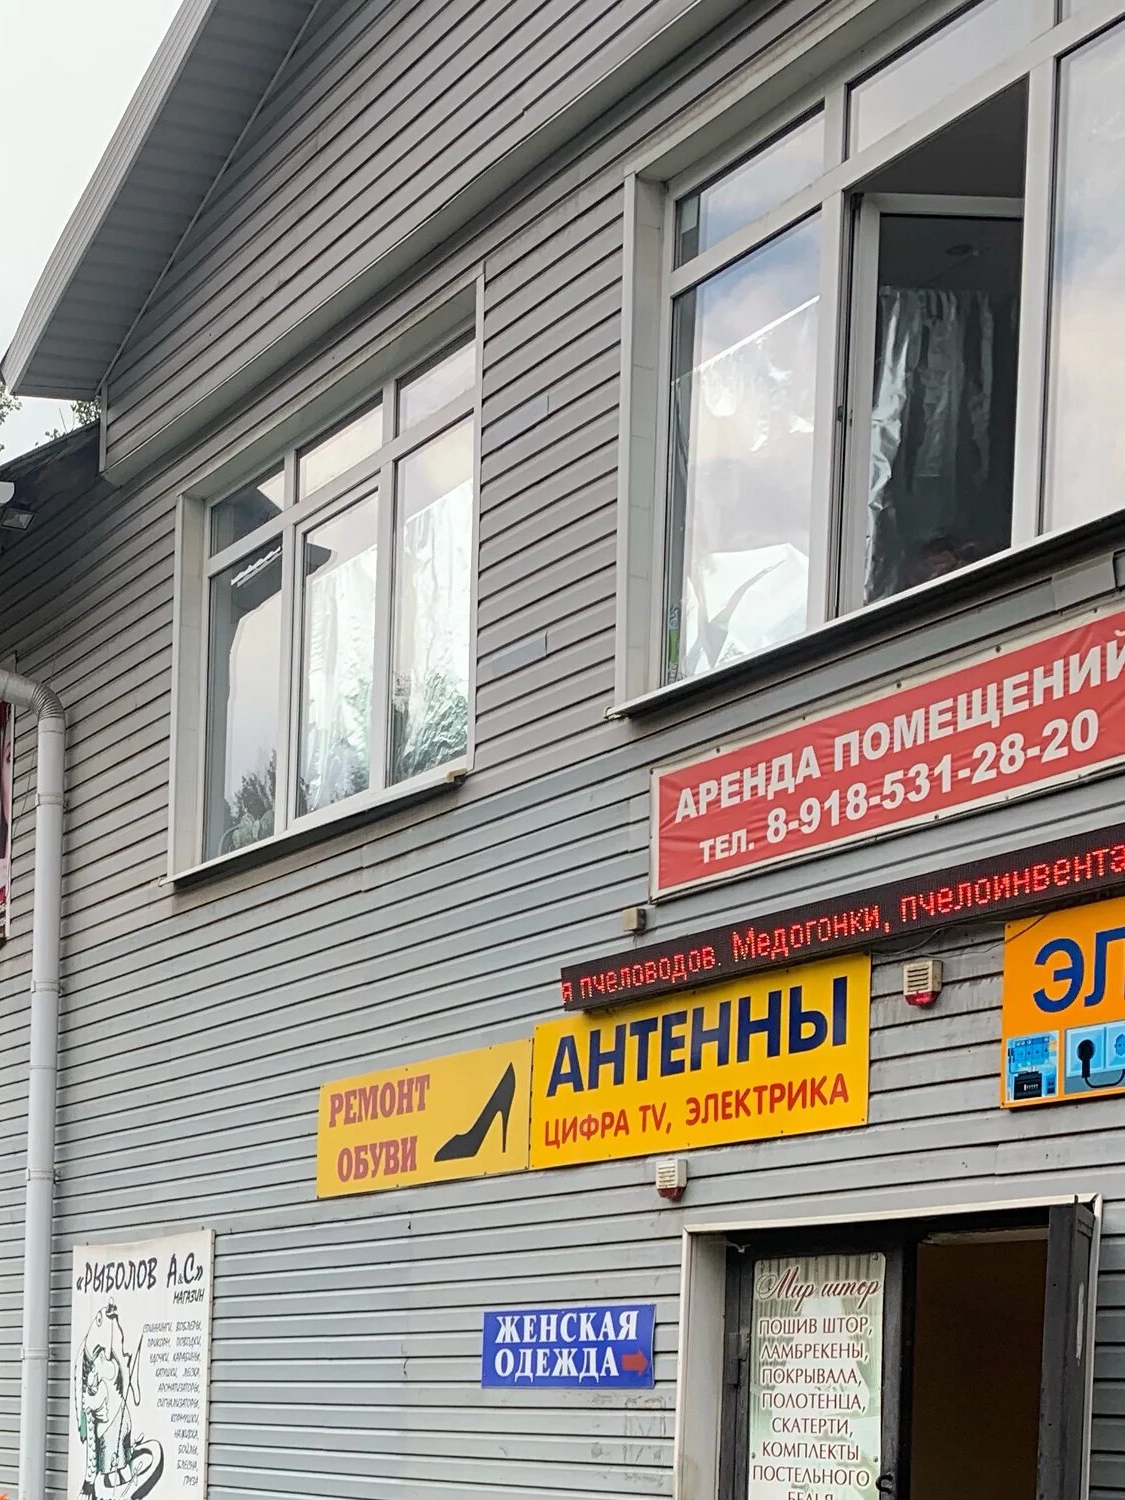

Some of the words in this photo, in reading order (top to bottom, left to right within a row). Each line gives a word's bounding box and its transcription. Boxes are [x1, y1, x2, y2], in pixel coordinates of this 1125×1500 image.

[675, 744, 823, 824] АРЕНДА
[766, 708, 1100, 844] 8-918-531-28-20
[579, 945, 722, 999] пчеловодов.
[731, 904, 891, 962] Медогонки,
[899, 843, 1125, 924] пчелоинвента
[546, 975, 849, 1098] АНТЕННЫ
[329, 1074, 430, 1128] РЕМОНТ
[544, 1114, 629, 1150] ЦИФРА
[638, 1102, 672, 1135] TV,
[685, 1072, 850, 1126] ЭЛЕКТРИКА
[337, 1136, 417, 1183] ОБУВИ
[76, 1257, 158, 1294] «РЫБОЛОВ
[756, 1266, 815, 1312] Мир
[821, 1280, 879, 1310] штор
[173, 1288, 206, 1305] МАГАЗИН
[494, 1310, 640, 1344] ЖЕНСКАЯ
[759, 1318, 817, 1335] ПОШИВ
[823, 1316, 873, 1336] ШТОР,
[494, 1346, 620, 1383] ОДЕЖДА
[761, 1343, 868, 1361] ЛАМБРЕКЕНЫ,
[762, 1368, 862, 1387] ПОКРЫВАЛА,
[762, 1392, 866, 1413] ПОЛОТЕНЦА,
[772, 1417, 854, 1438] СКАТЕРТИ,
[762, 1441, 859, 1461] КОМПЛЕКТЫ
[753, 1465, 870, 1487] ПОСТЕЛЬНОГО
